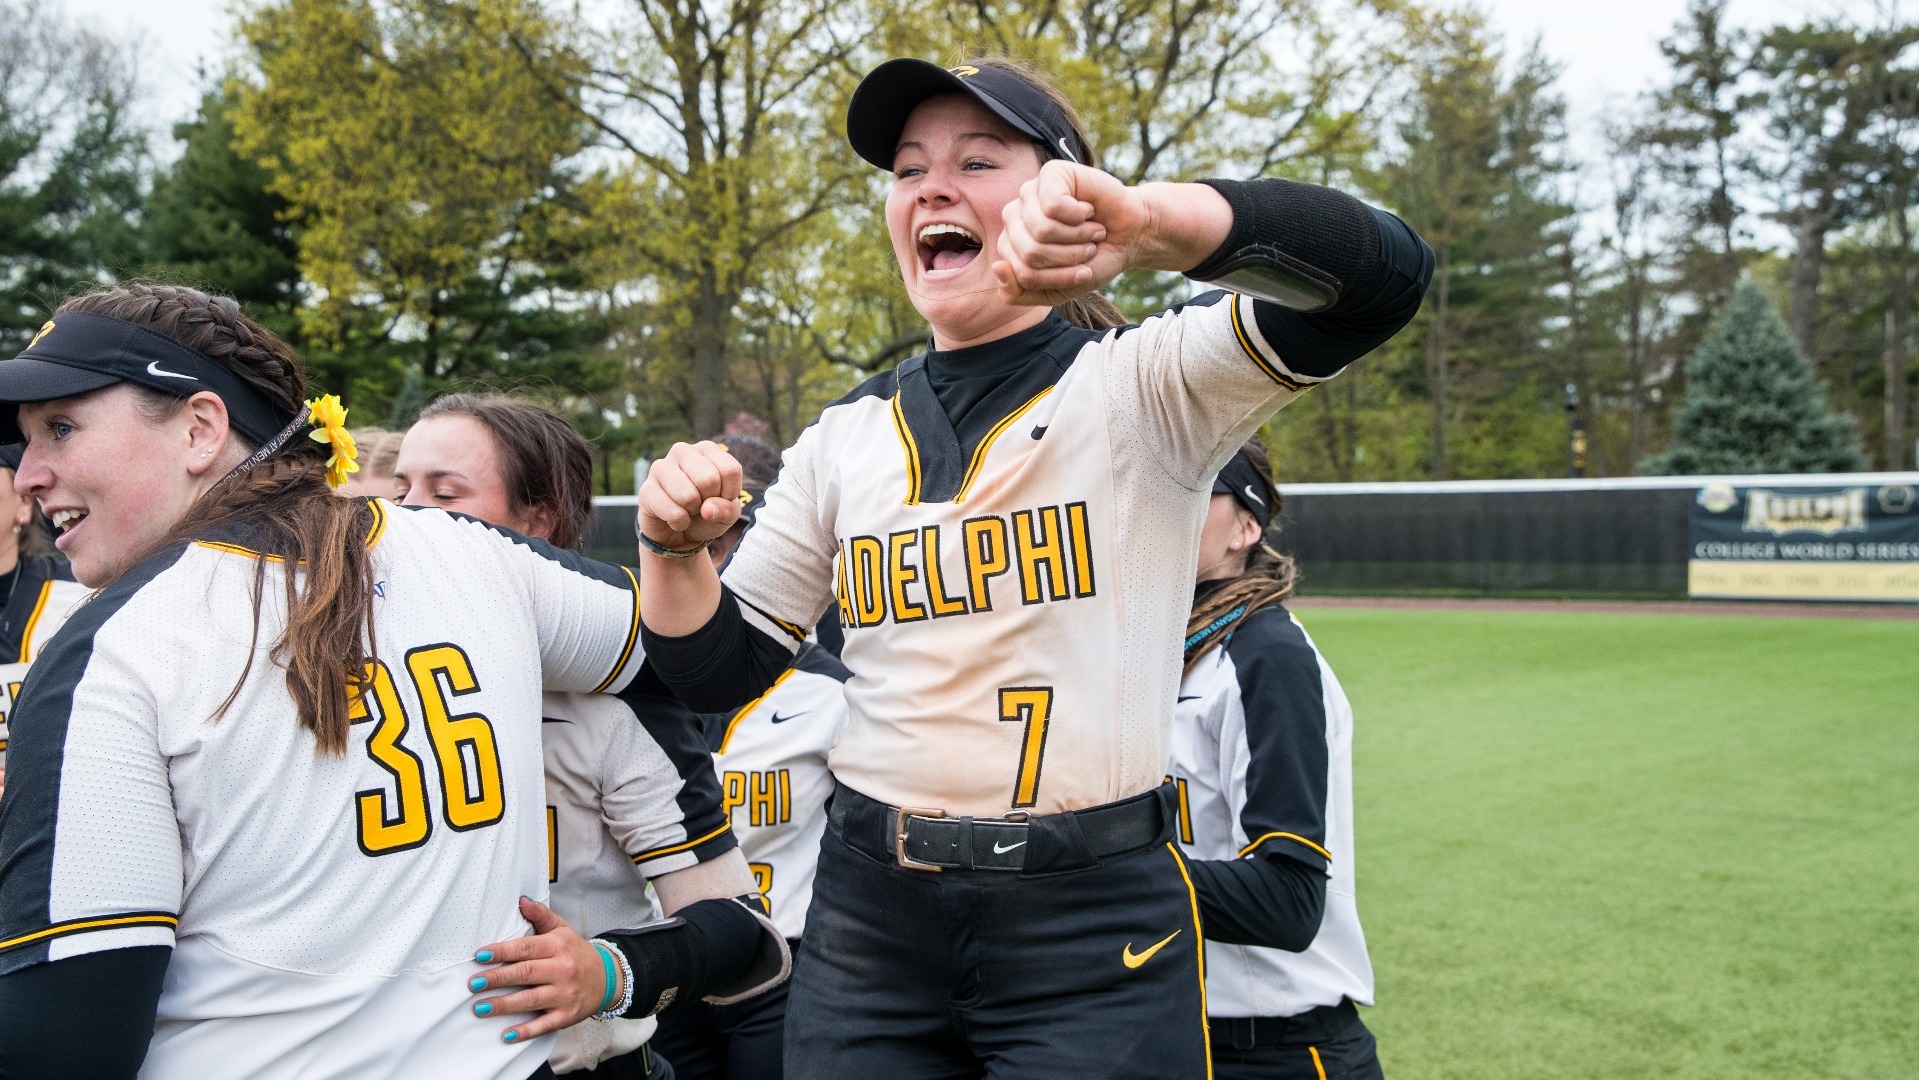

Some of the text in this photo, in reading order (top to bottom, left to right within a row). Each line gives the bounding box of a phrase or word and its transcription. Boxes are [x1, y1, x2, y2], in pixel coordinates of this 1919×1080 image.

[268, 440, 278, 453] AT
[277, 428, 293, 447] SHOT
[240, 447, 271, 473] MENTAL
[1695, 541, 1775, 559] COLLEGE
[1780, 541, 1855, 560] WORLD
[837, 501, 1096, 628] ADELPHI
[347, 642, 505, 857] 36
[998, 686, 1053, 808] 7
